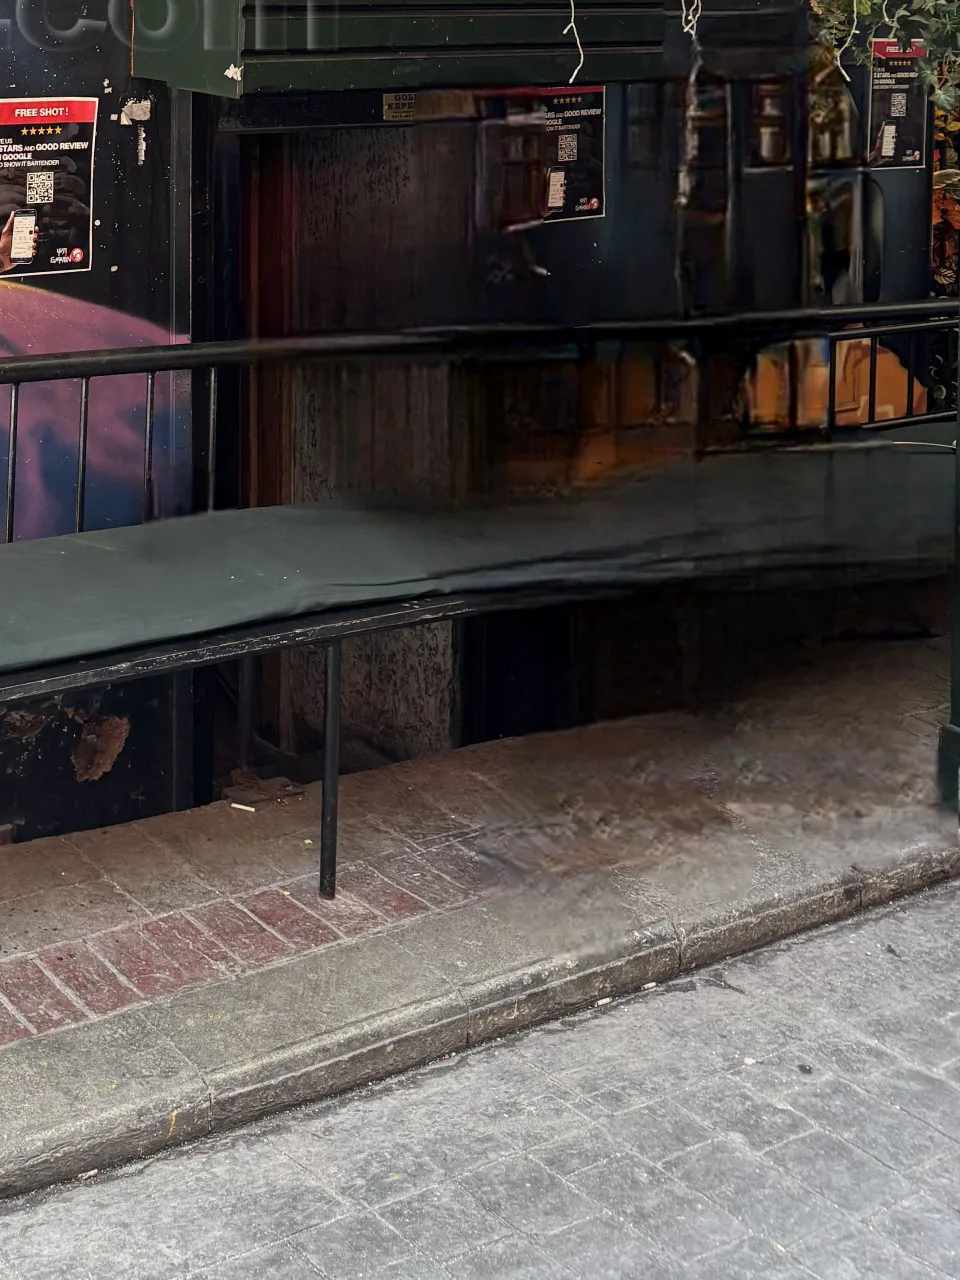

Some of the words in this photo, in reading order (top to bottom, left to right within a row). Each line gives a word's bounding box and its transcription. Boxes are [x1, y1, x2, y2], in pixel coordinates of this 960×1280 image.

[394, 93, 417, 102] GOL
[388, 102, 416, 110] KEPE
[14, 107, 38, 118] FREE
[39, 107, 64, 117] SHOT
[36, 143, 59, 151] GOOD
[59, 141, 89, 150] REVIEW
[2, 152, 33, 161] GOOGLE
[3, 160, 21, 168] SHOW
